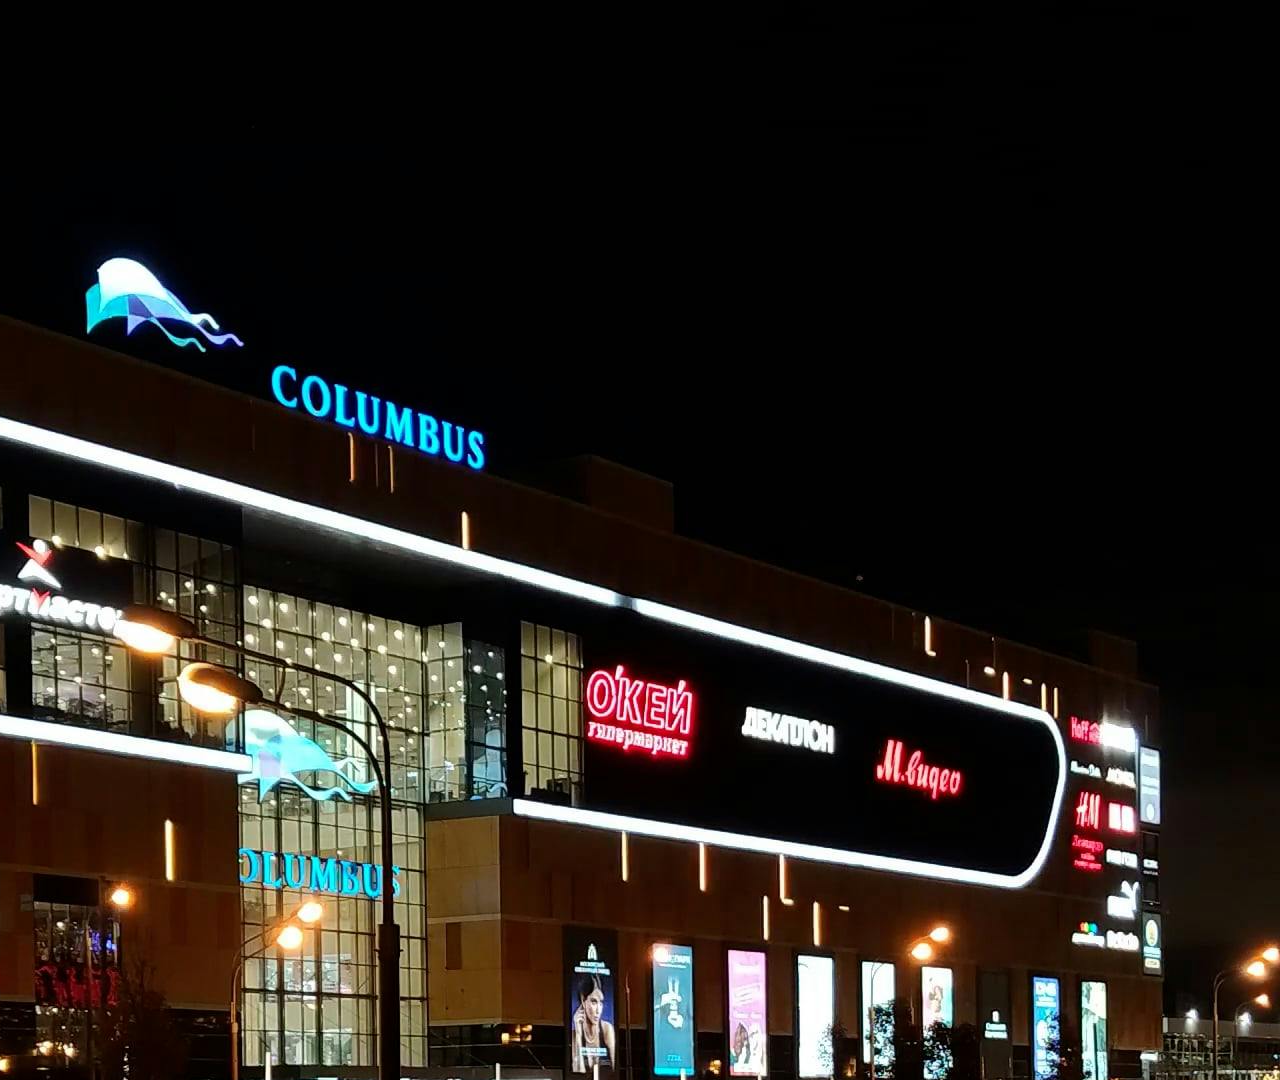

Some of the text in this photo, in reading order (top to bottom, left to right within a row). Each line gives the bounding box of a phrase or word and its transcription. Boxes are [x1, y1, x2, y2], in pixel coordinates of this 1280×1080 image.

[271, 365, 486, 470] COLUMBUS
[741, 706, 835, 754] ДЕКАТЛОН
[239, 848, 401, 898] OLUMBU
